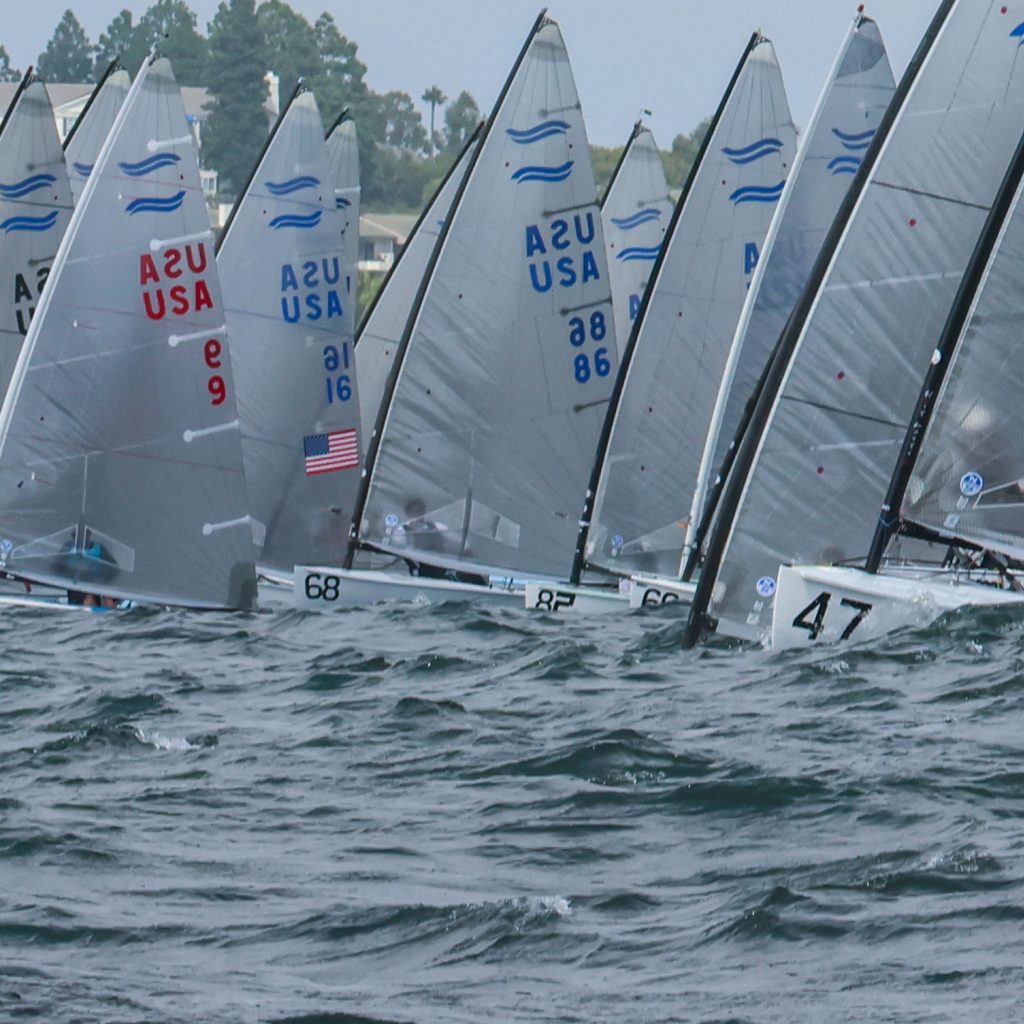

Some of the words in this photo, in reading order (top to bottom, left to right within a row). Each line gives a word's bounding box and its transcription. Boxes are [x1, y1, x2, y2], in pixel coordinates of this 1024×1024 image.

[529, 251, 600, 293] USA
[143, 280, 214, 321] USA
[281, 290, 343, 324] USA
[573, 348, 611, 383] 86
[208, 376, 226, 405] 9
[326, 375, 352, 404] 16
[304, 574, 340, 601] 68
[792, 591, 873, 641] 47
